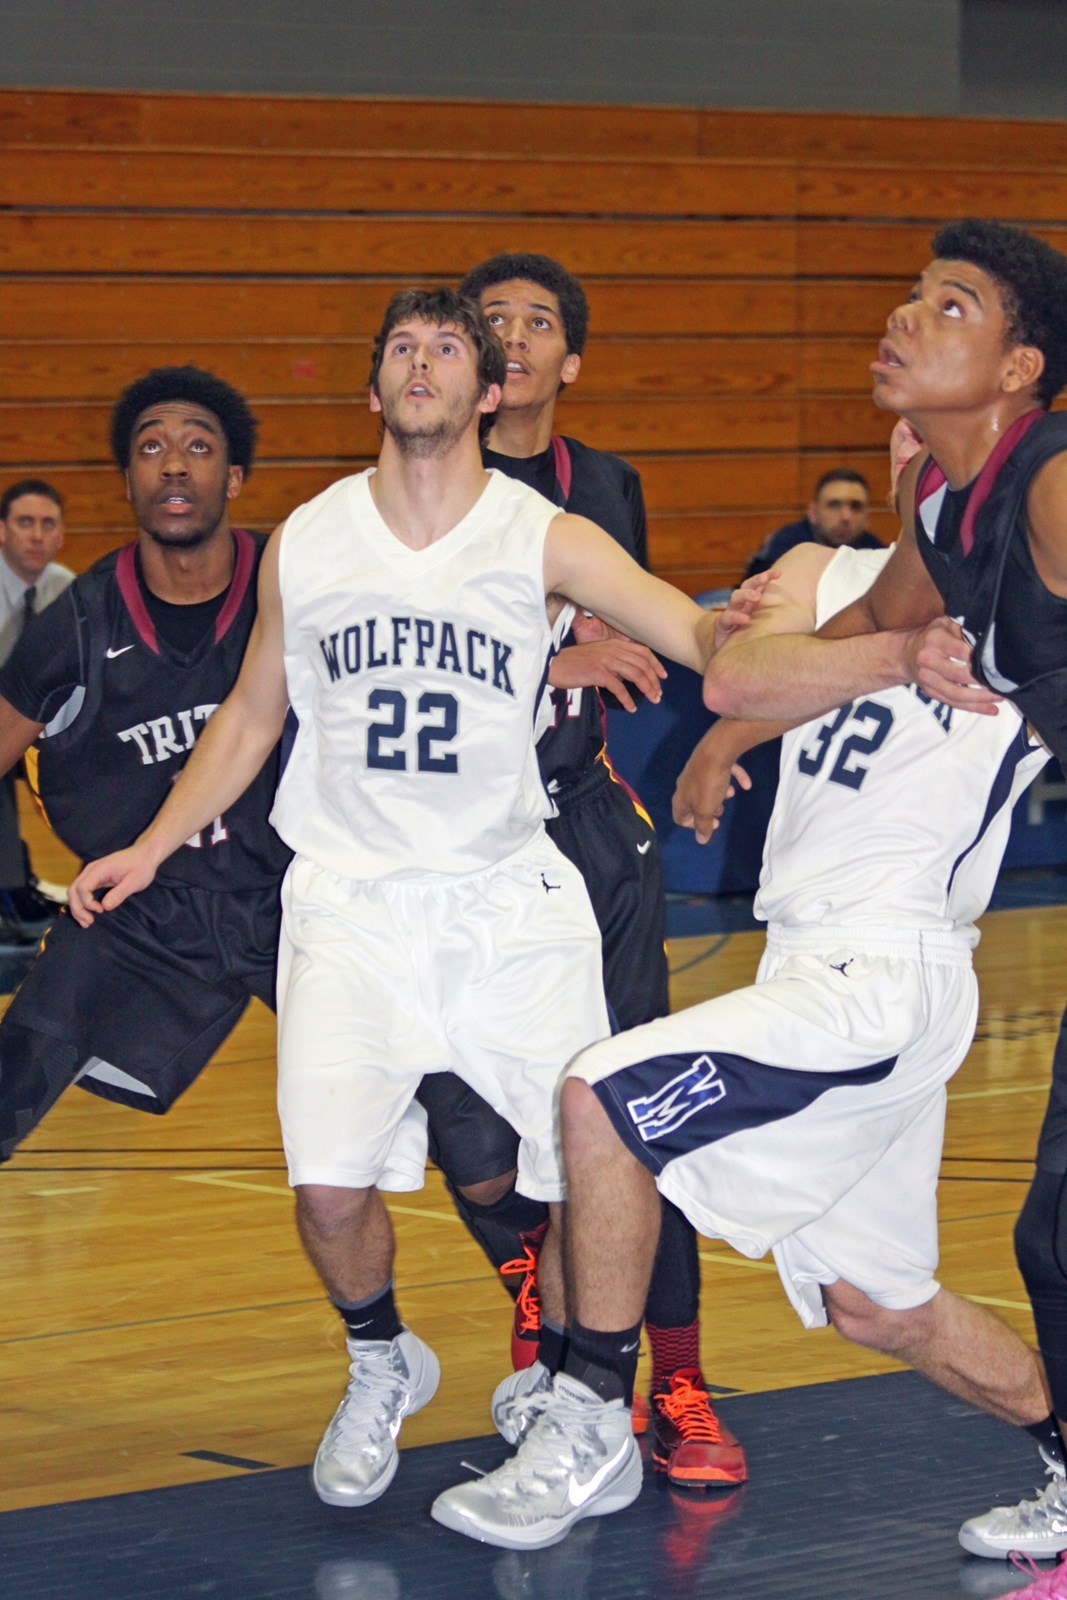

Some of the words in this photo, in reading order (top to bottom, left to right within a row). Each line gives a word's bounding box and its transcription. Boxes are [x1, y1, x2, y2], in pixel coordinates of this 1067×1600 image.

[319, 616, 516, 698] WOLFPACK
[366, 687, 459, 774] 22
[797, 699, 894, 791] 32
